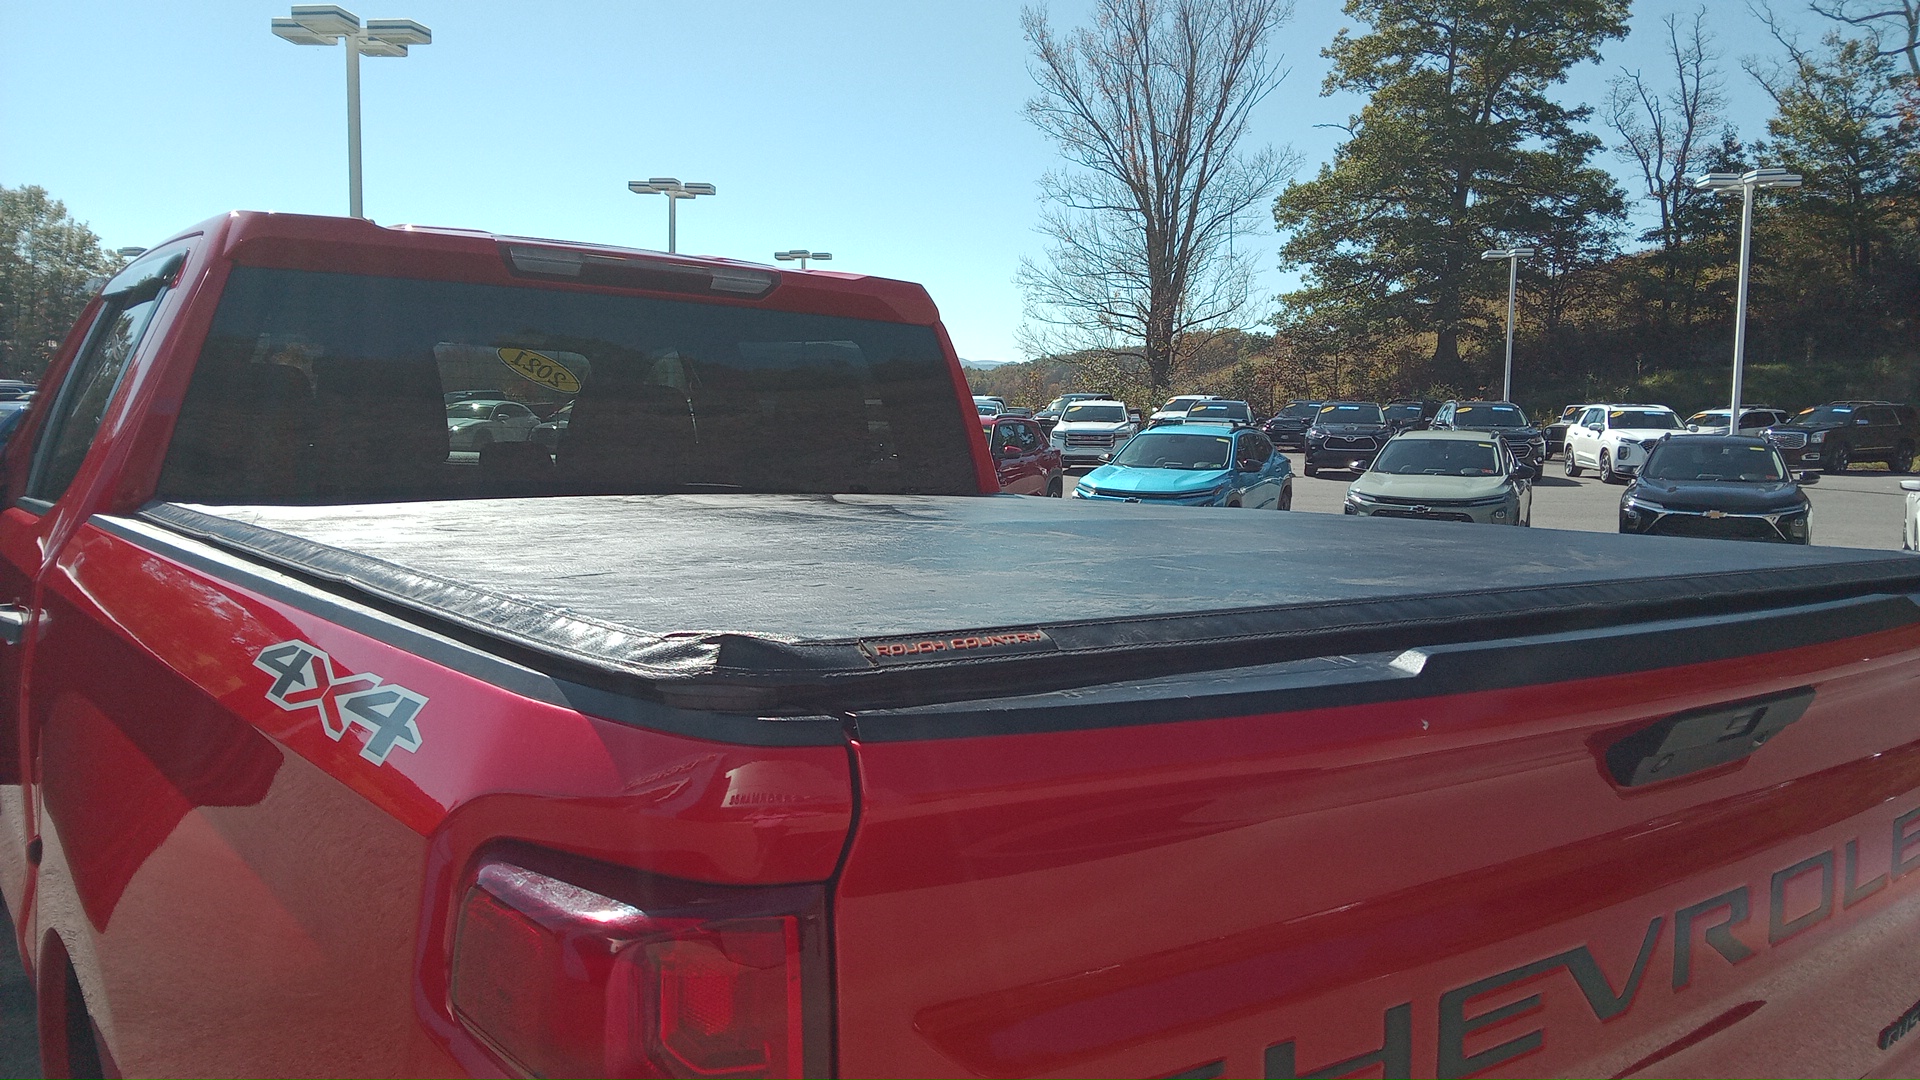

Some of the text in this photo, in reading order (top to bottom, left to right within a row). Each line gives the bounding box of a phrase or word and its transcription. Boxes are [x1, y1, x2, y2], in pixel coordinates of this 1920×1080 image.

[874, 631, 1041, 657] ROUGH COUNTRY
[1172, 806, 1920, 1080] HEVROLE
